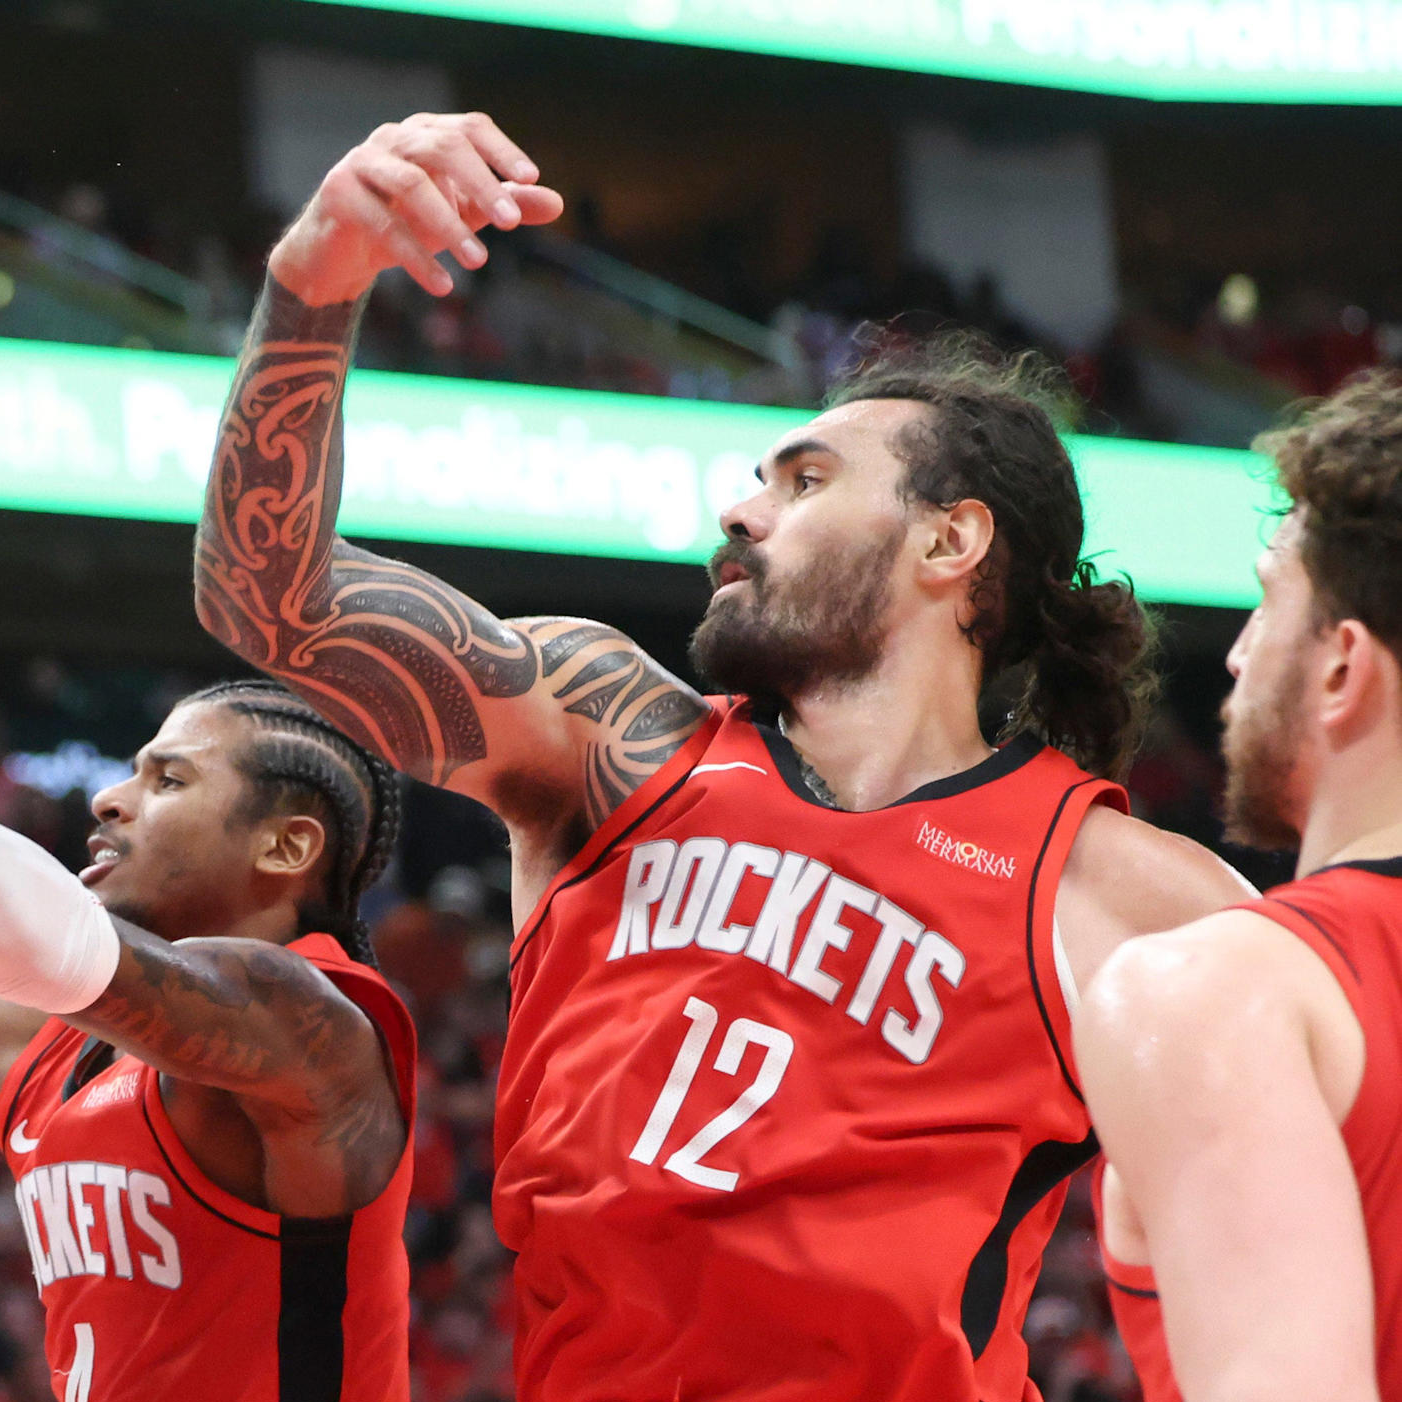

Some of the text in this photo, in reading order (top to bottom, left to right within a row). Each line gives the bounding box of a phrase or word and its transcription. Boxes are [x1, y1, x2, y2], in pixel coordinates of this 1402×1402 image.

[916, 834, 1016, 878] HERMANN
[919, 821, 1016, 869] MEMORIAL
[605, 836, 968, 1065] ROCKETS
[628, 995, 795, 1192] 12
[15, 1160, 182, 1298] CKETS
